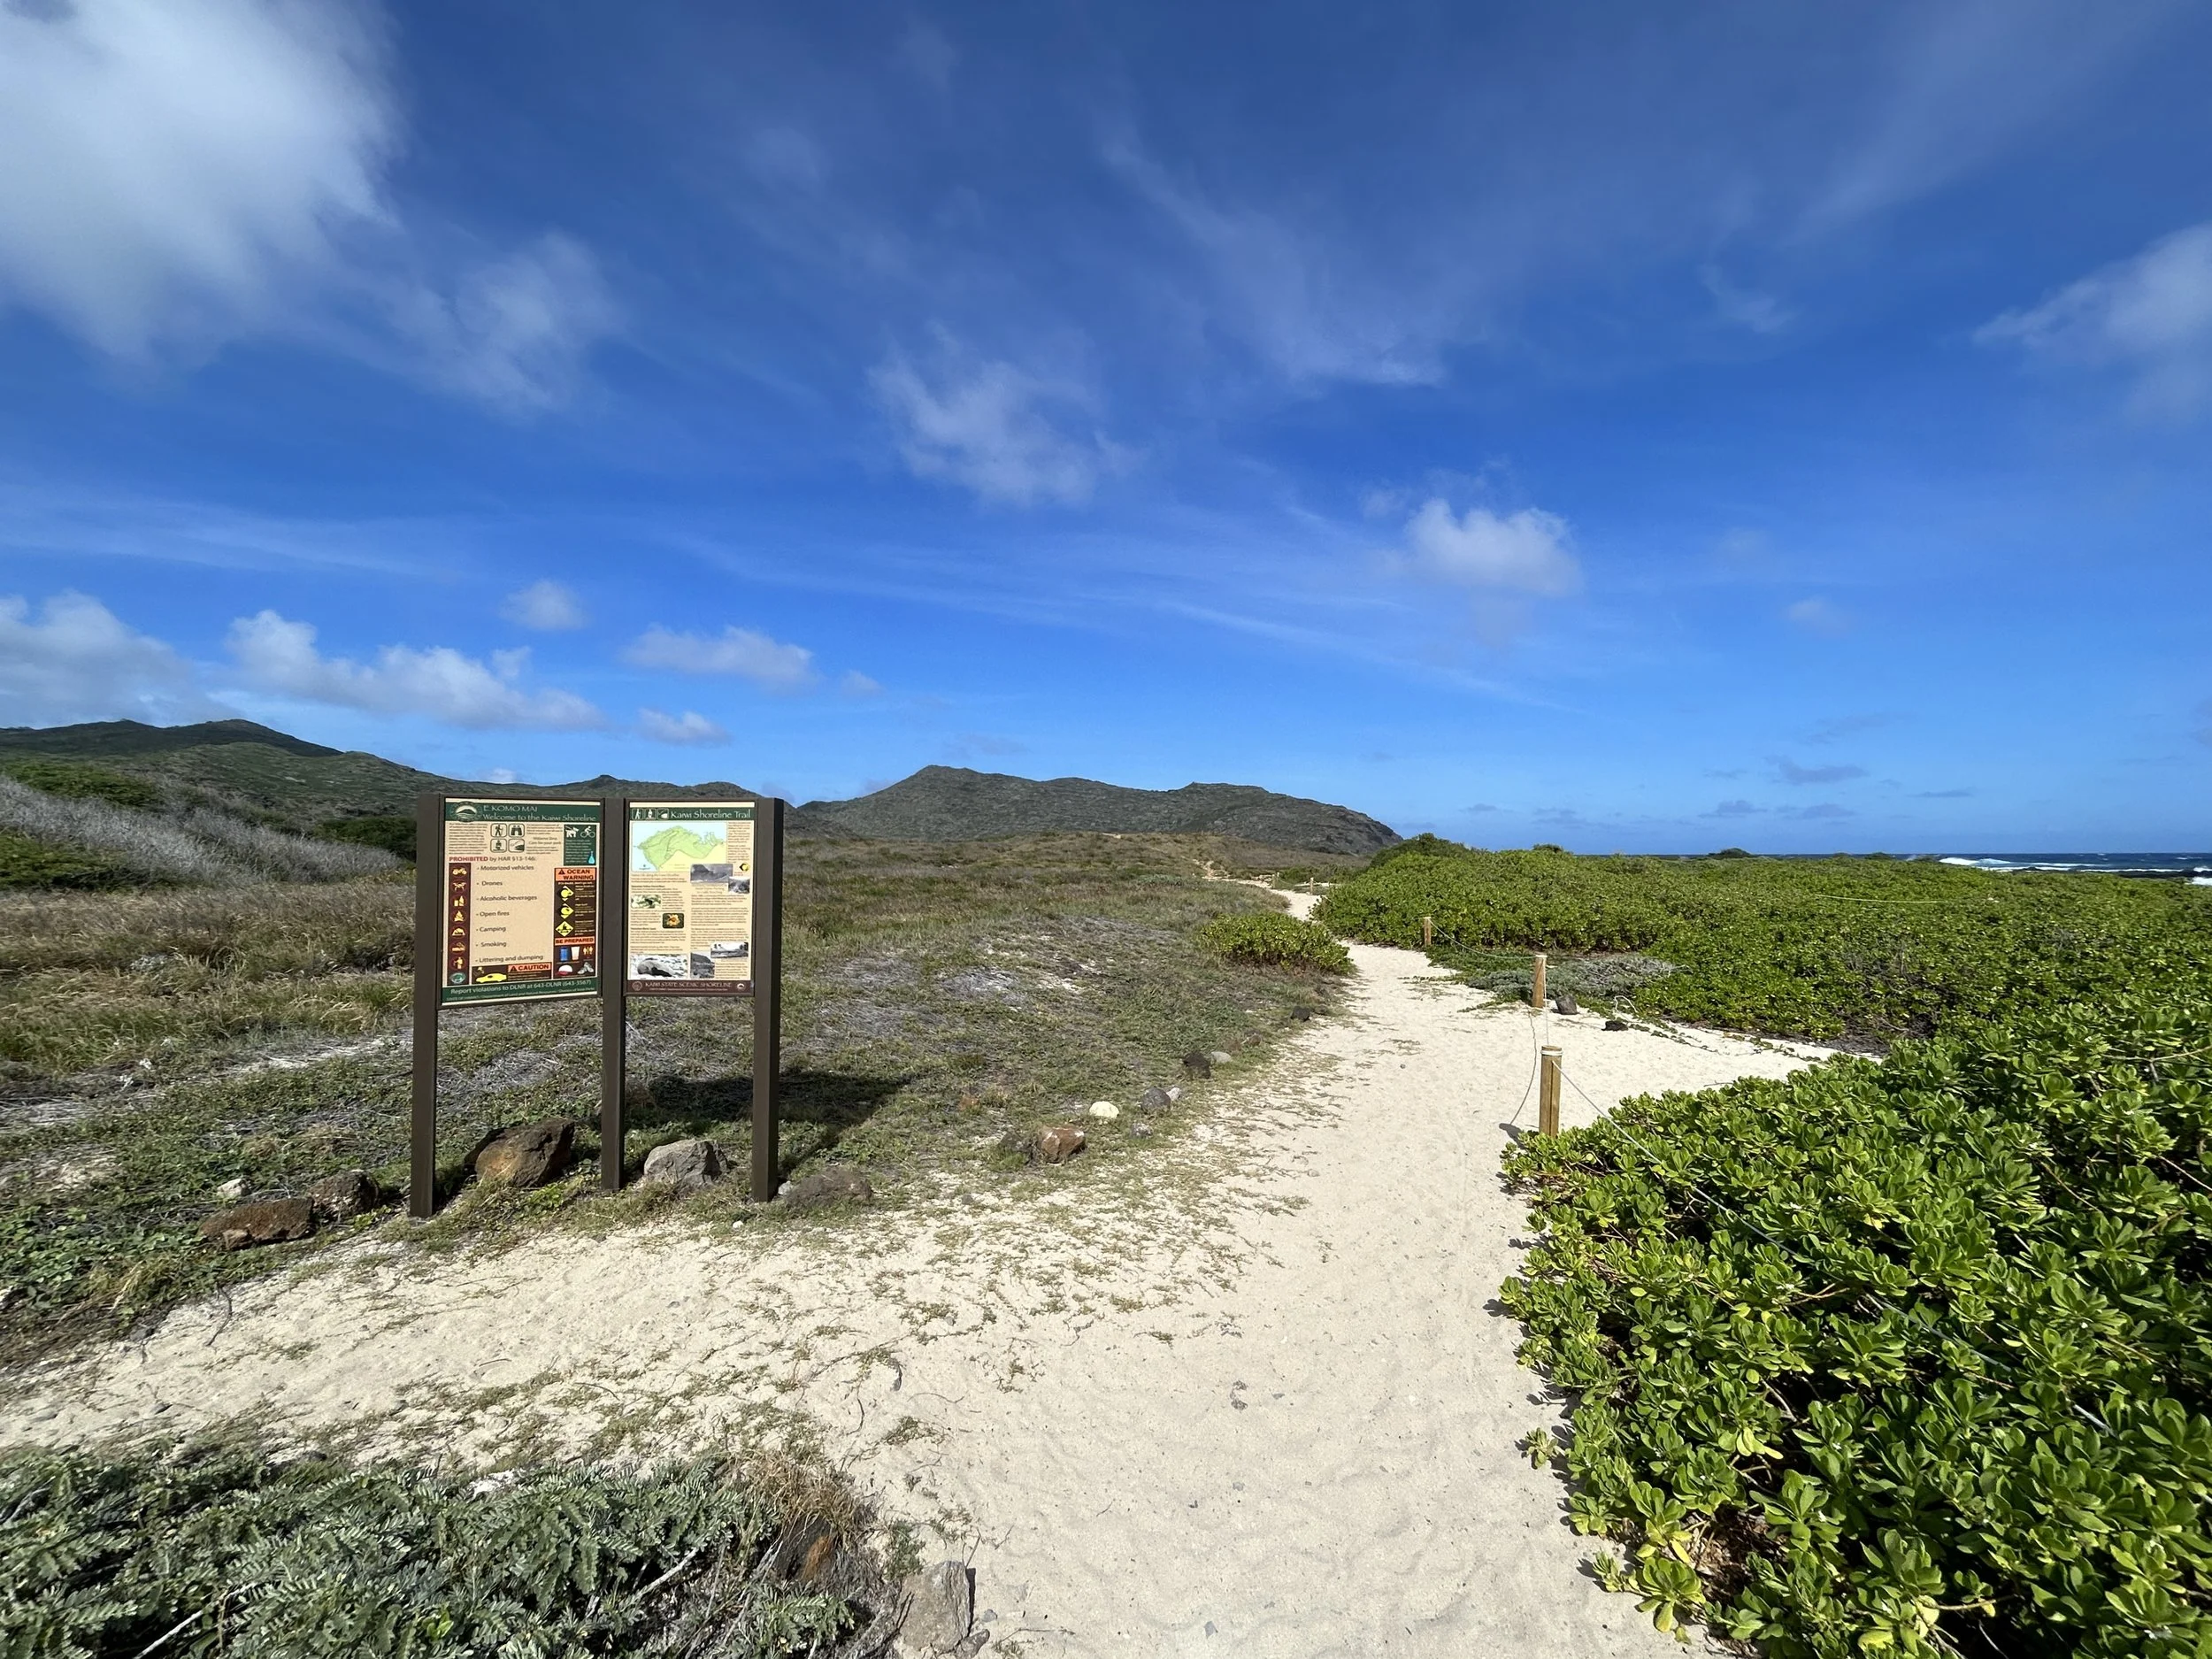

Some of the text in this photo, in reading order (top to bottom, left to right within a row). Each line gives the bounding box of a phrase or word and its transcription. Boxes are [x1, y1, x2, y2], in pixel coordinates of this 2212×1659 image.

[670, 809, 751, 818] Kaiwi Shoreline Trail
[534, 980, 562, 989] 643-DLNR
